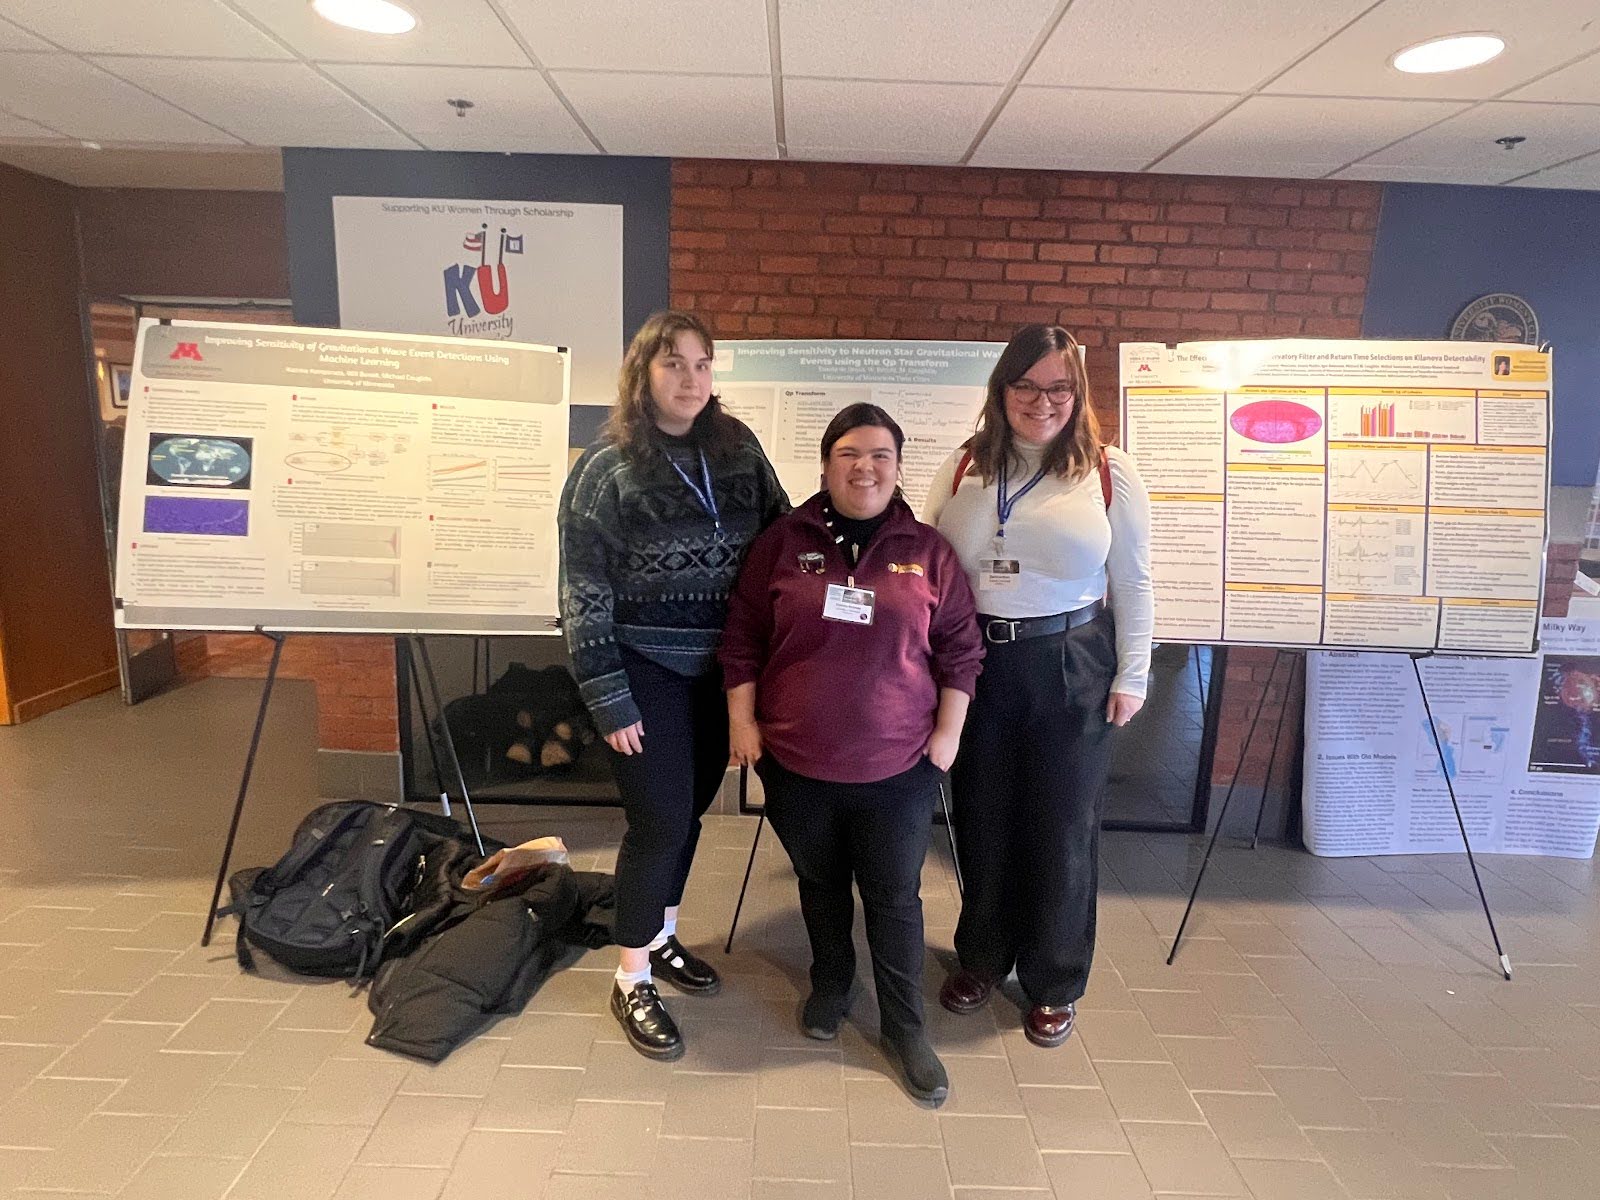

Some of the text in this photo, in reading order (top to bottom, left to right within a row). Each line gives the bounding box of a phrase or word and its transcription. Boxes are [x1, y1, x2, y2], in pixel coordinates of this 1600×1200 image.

[382, 203, 574, 218] Supporting KU Women Through Scholarship
[443, 262, 509, 318] KU
[448, 313, 513, 338] University
[205, 336, 510, 366] Improving Sensitivity of Gravitational Wave Event Detections Using
[737, 348, 786, 357] Improving
[788, 347, 837, 356] Sensitivity
[852, 348, 891, 356] Neutron
[894, 348, 914, 356] Star
[916, 348, 979, 358] Gravitational
[319, 354, 400, 369] Machine Learning
[834, 358, 860, 367] using
[863, 358, 880, 366] the
[882, 358, 896, 367] Qp
[899, 359, 949, 368] Transform
[1299, 353, 1319, 361] Filter
[1330, 353, 1352, 361] Return
[1444, 354, 1485, 363] Detectability
[1543, 623, 1586, 633] Milky Way
[1518, 789, 1564, 797] Conclusions
